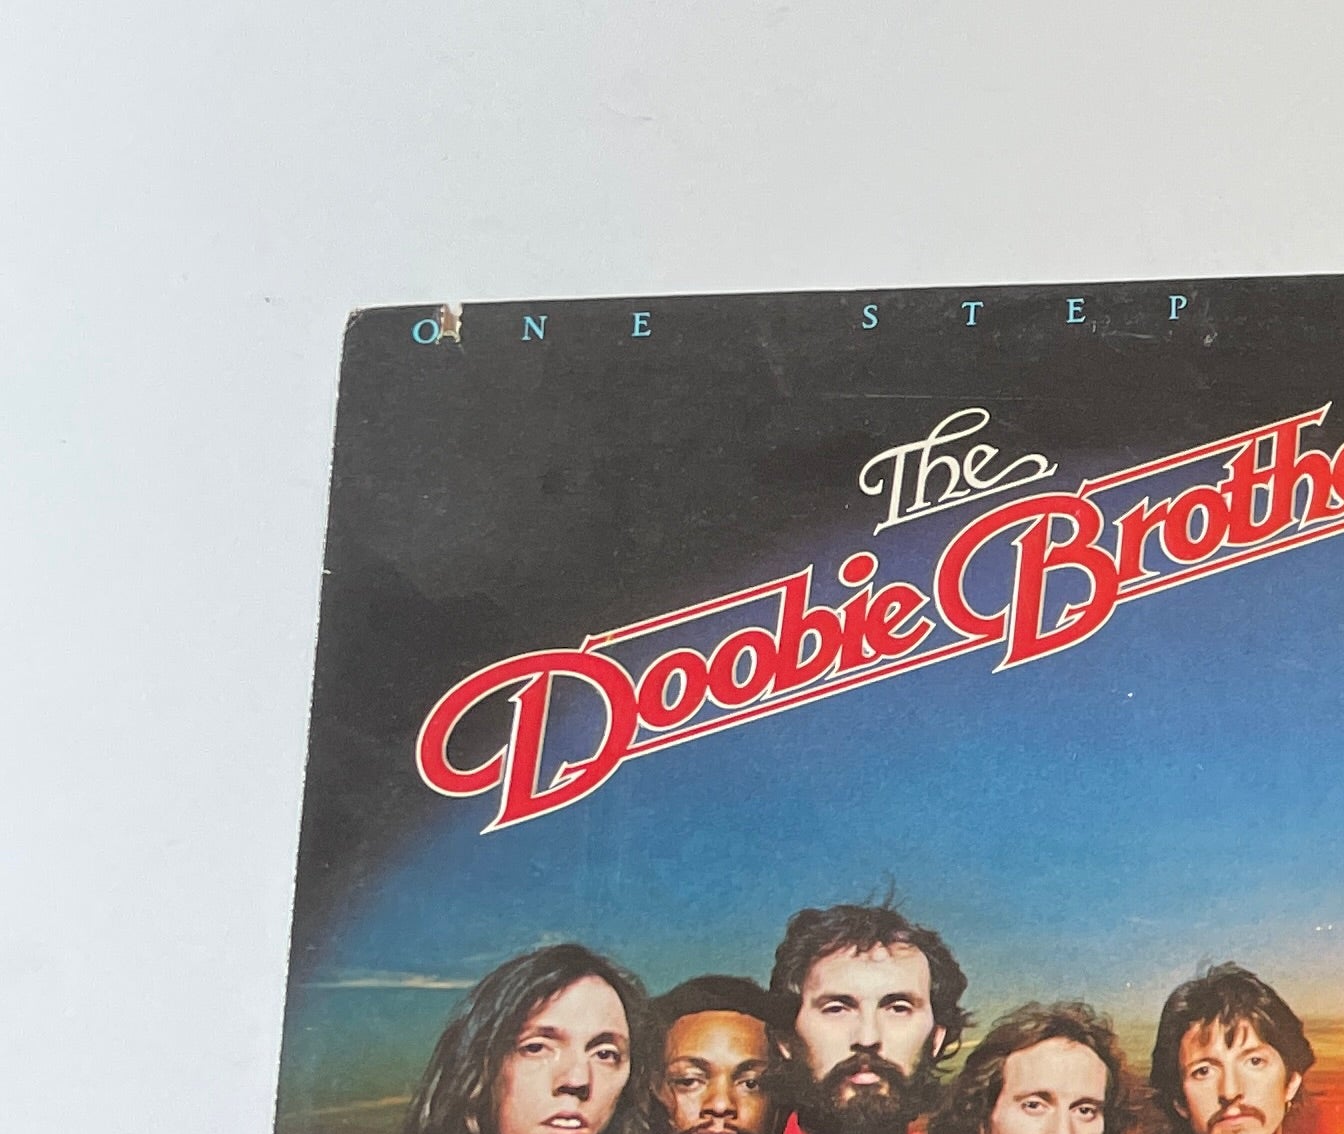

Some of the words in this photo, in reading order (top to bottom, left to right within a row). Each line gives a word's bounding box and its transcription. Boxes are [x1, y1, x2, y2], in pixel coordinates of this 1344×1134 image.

[412, 312, 651, 345] ONE
[862, 295, 1188, 330] STEP
[858, 406, 1058, 535] The
[415, 552, 937, 835] Doobie
